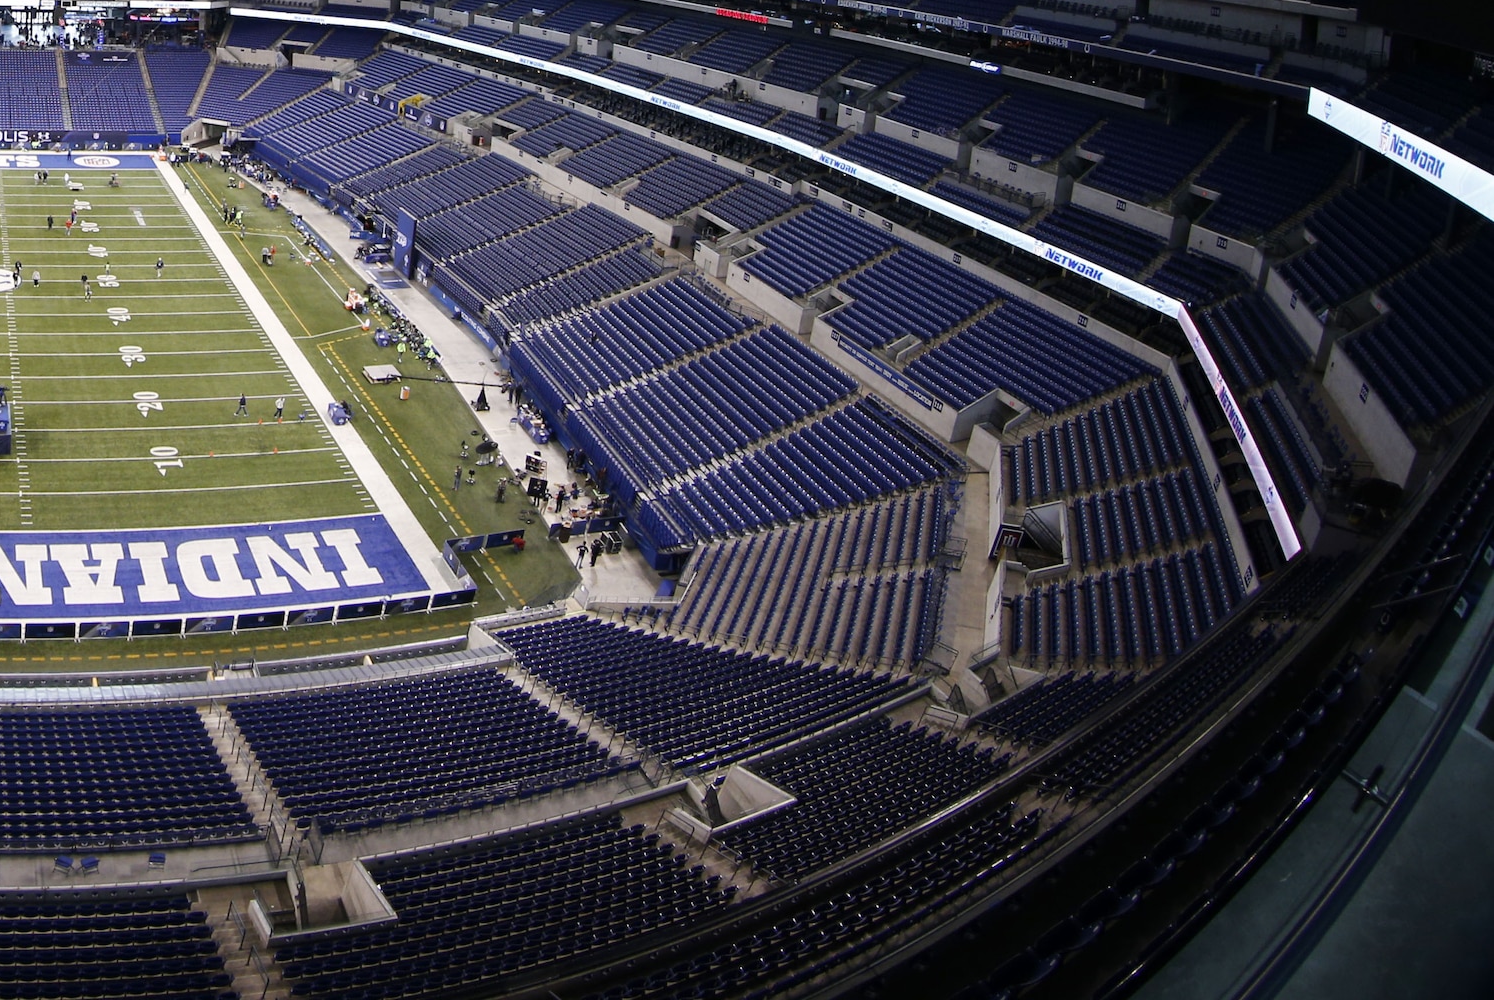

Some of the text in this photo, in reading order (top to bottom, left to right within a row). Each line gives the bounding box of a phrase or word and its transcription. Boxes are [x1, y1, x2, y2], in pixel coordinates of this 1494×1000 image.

[651, 97, 681, 110] NETWORK
[819, 153, 857, 176] NETWORK
[1390, 134, 1445, 179] NETWORK
[1045, 246, 1103, 283] NETWORK
[106, 307, 132, 322] 40
[118, 346, 146, 363] 30
[132, 391, 164, 413] 20
[1219, 385, 1247, 444] NETWORK
[149, 446, 184, 470] 10
